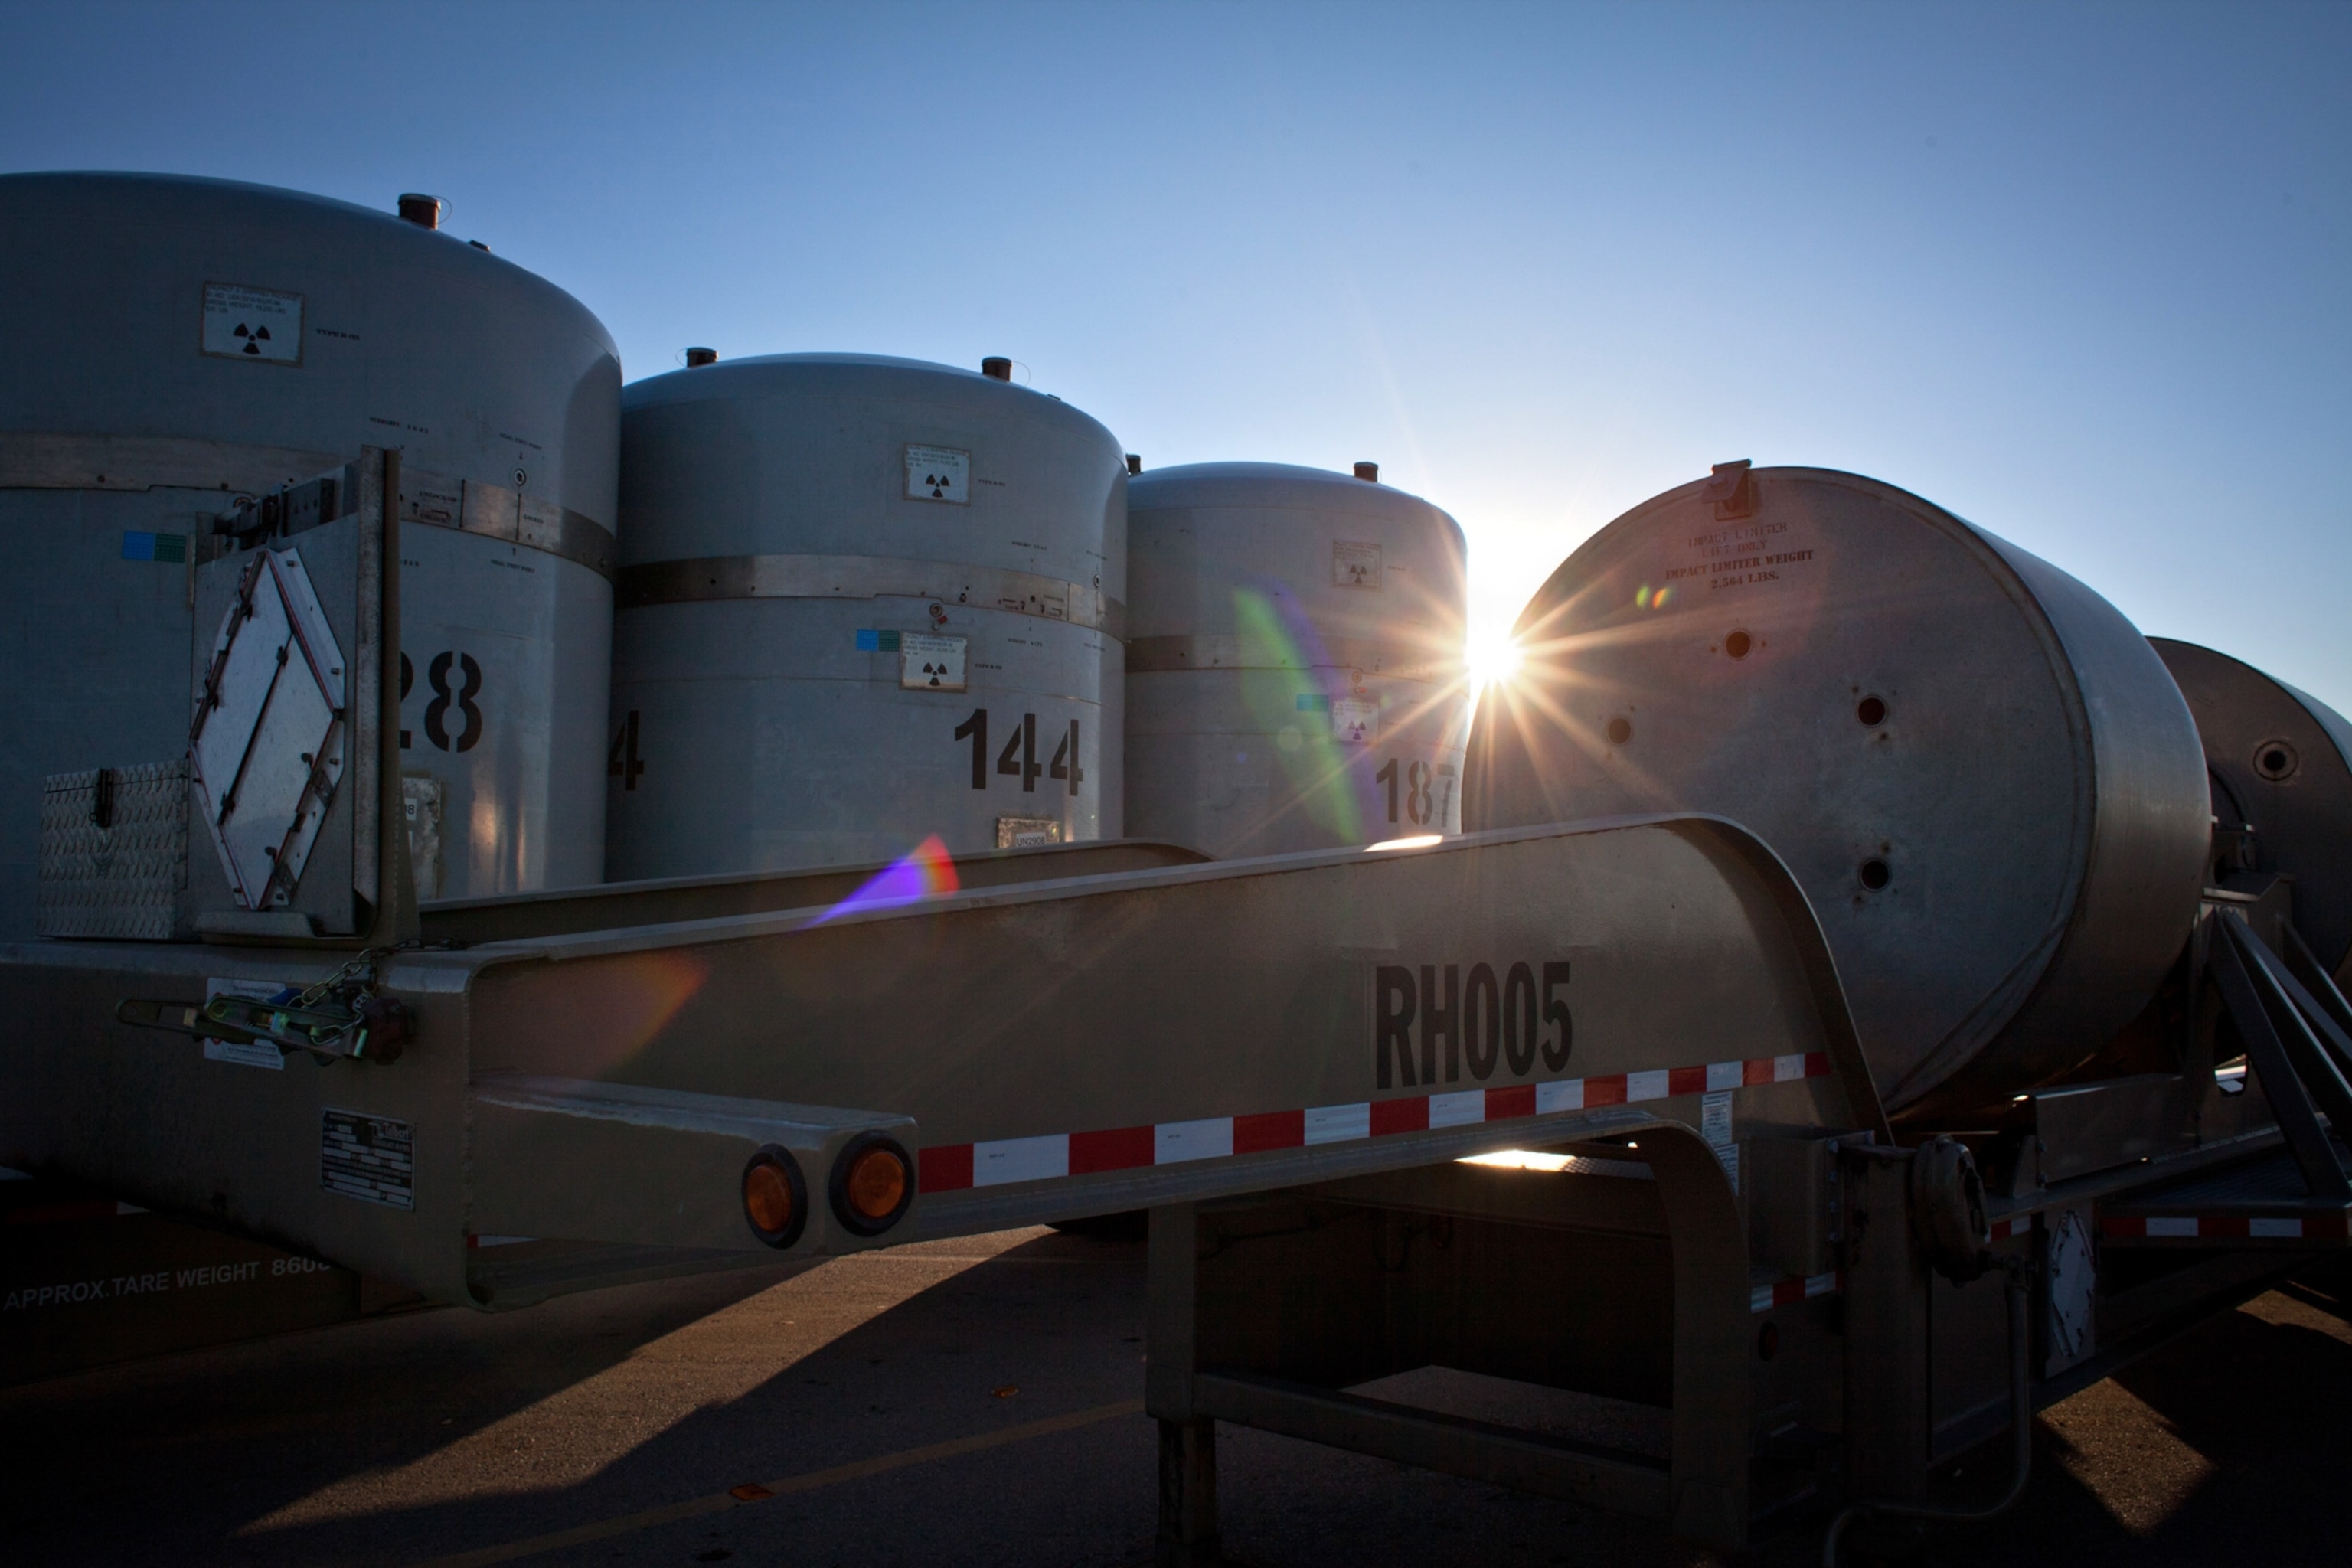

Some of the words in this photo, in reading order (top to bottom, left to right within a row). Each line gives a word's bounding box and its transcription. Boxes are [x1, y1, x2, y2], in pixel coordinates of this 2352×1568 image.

[1688, 532, 1728, 548] IMPACT
[1735, 522, 1787, 540] LIMITER
[1737, 539, 1768, 553] ONLY
[1665, 565, 1708, 580] IMPACT
[1711, 557, 1761, 573] LIMITER
[1765, 549, 1814, 567] WEIGHT
[1710, 575, 1743, 590] 2,564
[1747, 570, 1779, 584] LBS.
[955, 708, 1084, 797] 144
[1376, 758, 1455, 828] 187
[1017, 836, 1045, 847] UN2908
[1376, 961, 1573, 1090] RH005
[383, 1121, 410, 1140] Talbert
[111, 1272, 170, 1298] TARE
[176, 1261, 261, 1289] WEIGHT
